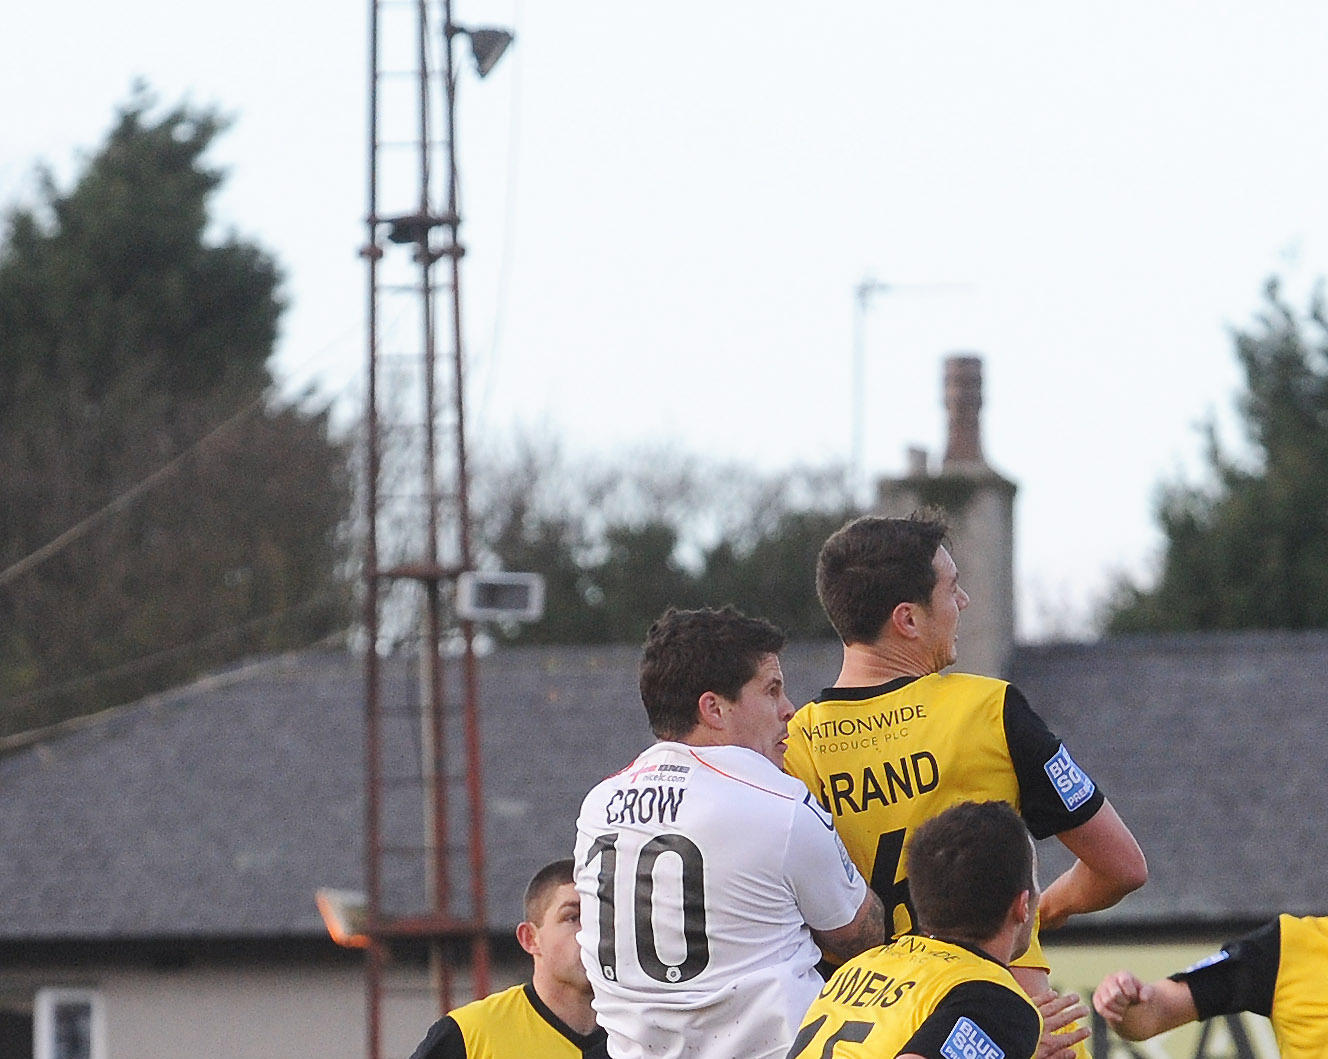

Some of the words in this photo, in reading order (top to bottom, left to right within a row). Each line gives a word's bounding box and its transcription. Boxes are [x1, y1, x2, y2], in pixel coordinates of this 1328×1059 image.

[884, 726, 909, 743] PLC
[606, 785, 687, 825] CROW
[819, 751, 940, 817] RAND
[585, 832, 711, 984] 10
